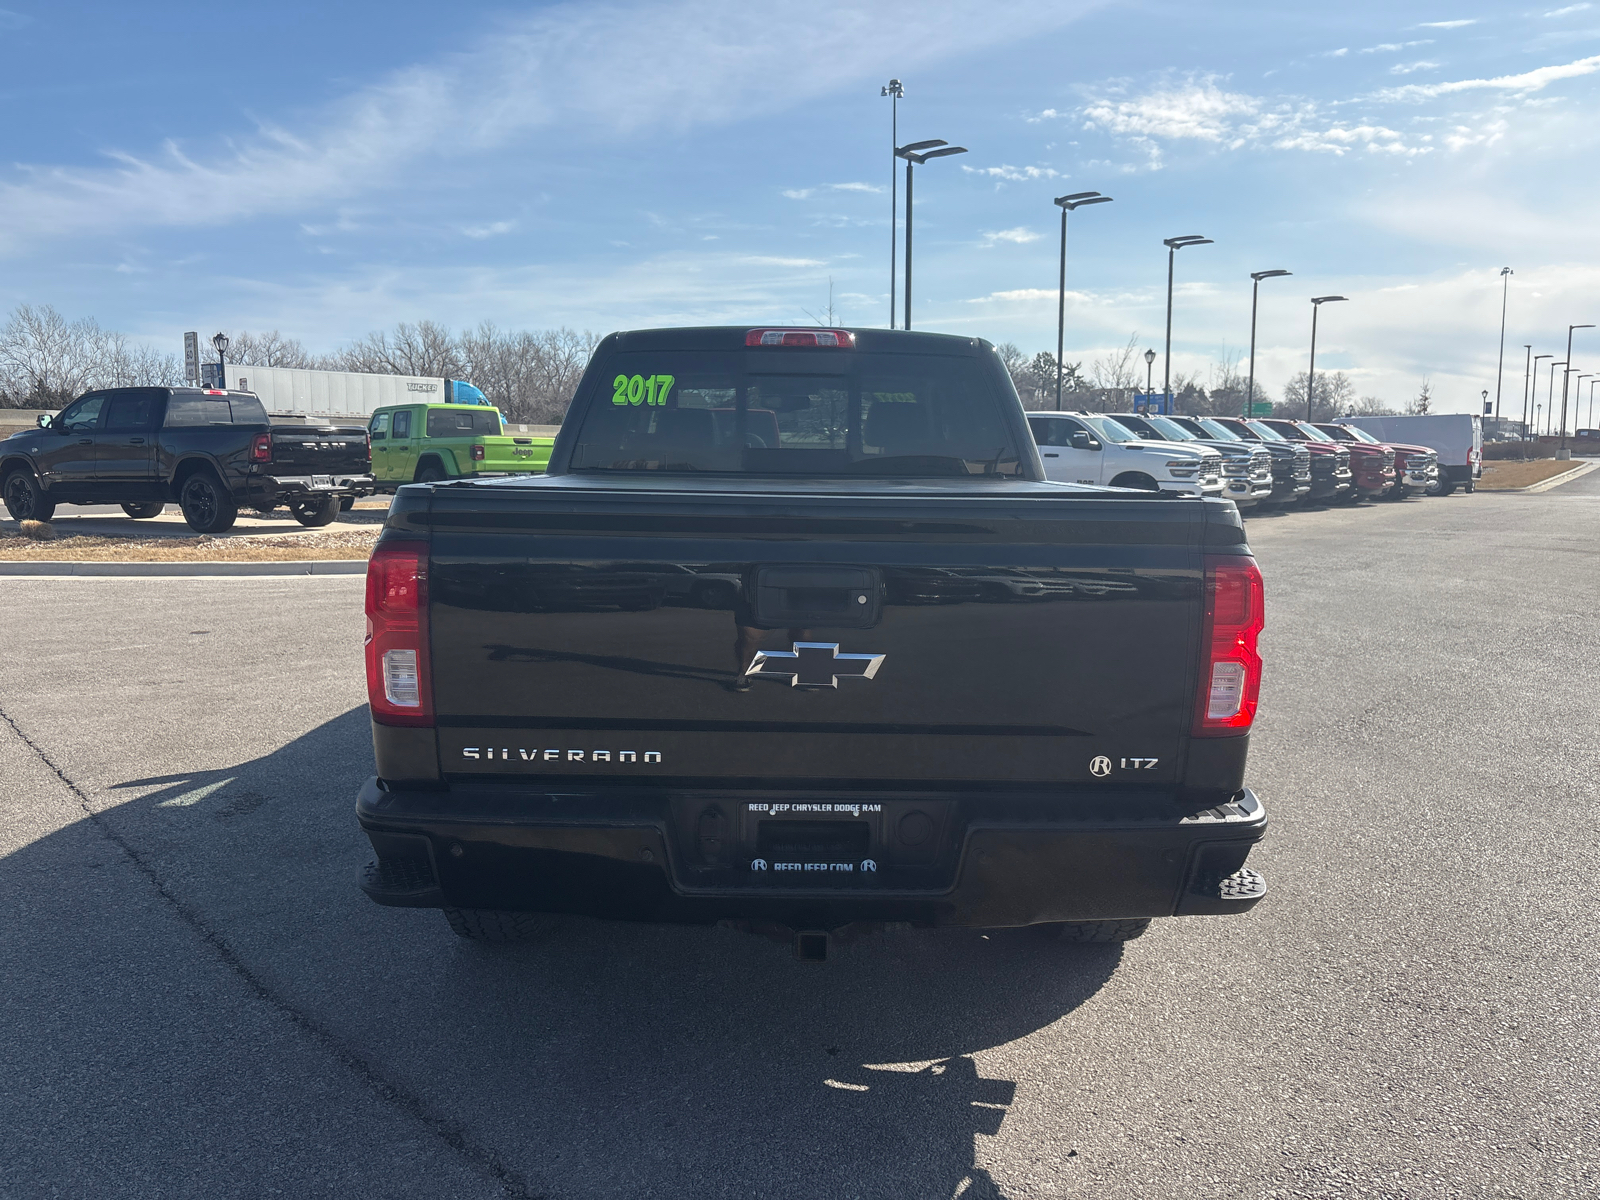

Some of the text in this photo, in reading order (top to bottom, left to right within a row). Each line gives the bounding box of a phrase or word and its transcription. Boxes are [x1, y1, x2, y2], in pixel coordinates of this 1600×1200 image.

[407, 383, 438, 392] TUCKER
[612, 374, 675, 406] 2017
[512, 447, 533, 457] Jeep
[463, 747, 661, 764] SILVERADO
[1120, 758, 1158, 769] LTZ
[748, 803, 881, 812] REED JEEP CHRYSLER DODGE RAM
